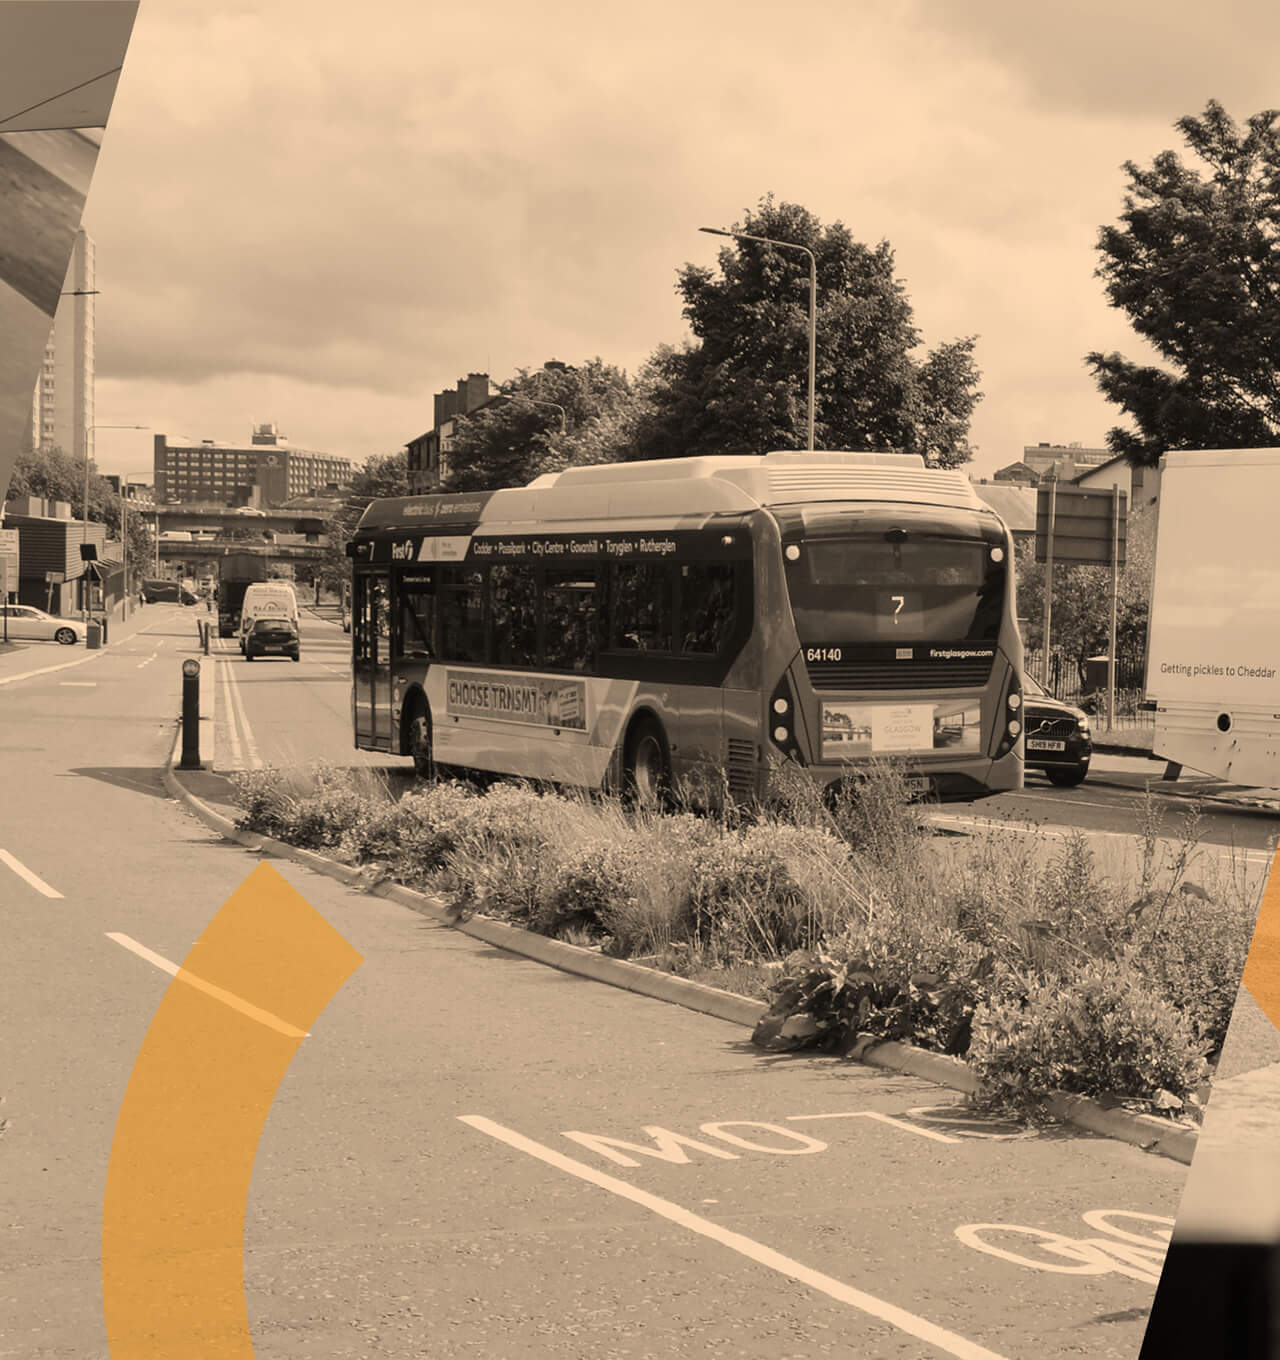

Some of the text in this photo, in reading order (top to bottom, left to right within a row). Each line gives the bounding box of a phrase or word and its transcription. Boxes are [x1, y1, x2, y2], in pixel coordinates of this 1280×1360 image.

[640, 538, 677, 555] Rutherglen
[891, 596, 905, 625] 7
[807, 648, 842, 661] 64140
[929, 648, 994, 659] firstglasgow.com
[1160, 663, 1276, 678] Getting pickles to Cheddar
[449, 679, 489, 709] CHOOSE
[560, 1103, 1040, 1168] SLOW
